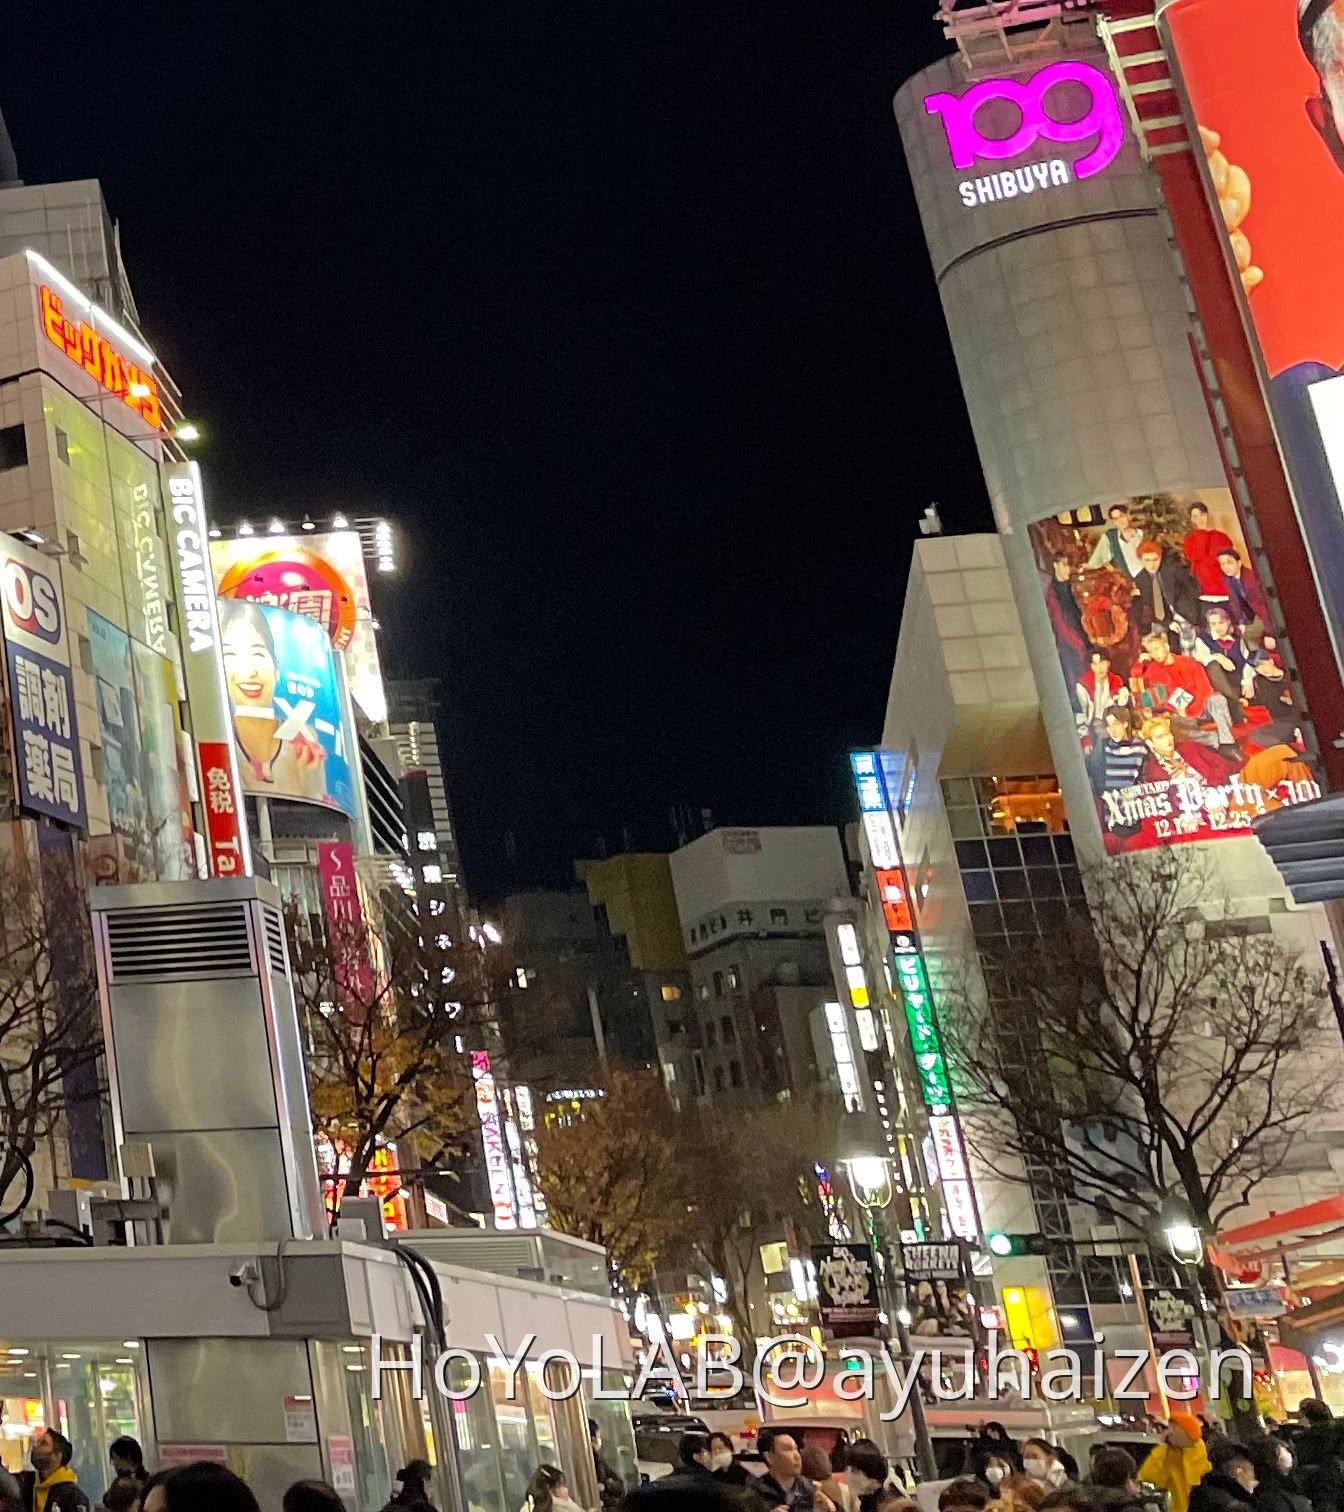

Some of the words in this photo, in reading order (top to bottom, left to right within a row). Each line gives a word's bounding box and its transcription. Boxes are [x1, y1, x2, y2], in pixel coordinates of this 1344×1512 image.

[924, 61, 1125, 180] 109
[959, 159, 1070, 208] SHIBUYA
[168, 477, 197, 526] BIC
[6, 558, 60, 644] OS
[176, 528, 215, 653] CAMERA
[14, 654, 70, 738] 調剤
[22, 729, 80, 813] 薬局
[214, 836, 238, 879] Ta
